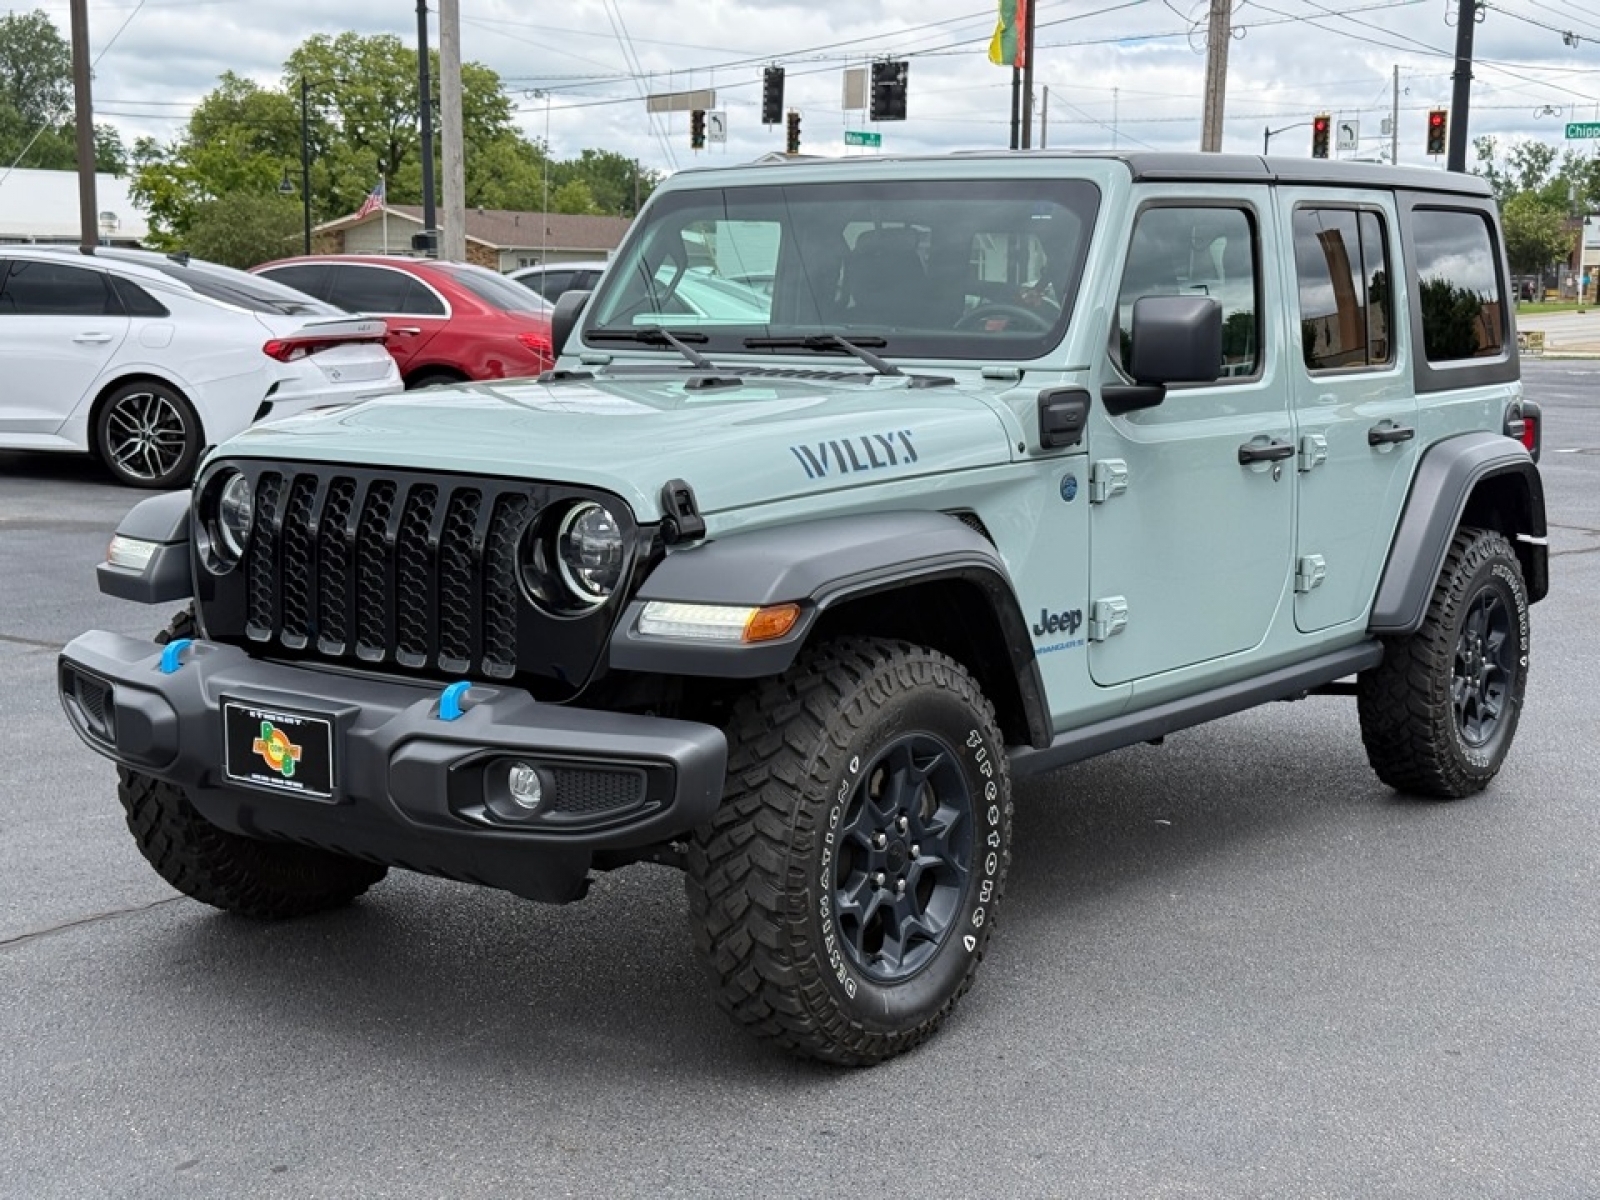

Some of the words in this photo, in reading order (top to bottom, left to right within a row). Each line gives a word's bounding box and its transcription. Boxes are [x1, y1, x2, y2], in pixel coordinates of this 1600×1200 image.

[846, 133, 863, 145] Main
[790, 429, 918, 479] WILLYS
[1033, 608, 1082, 636] Jeep
[819, 779, 857, 999] DESTINATION
